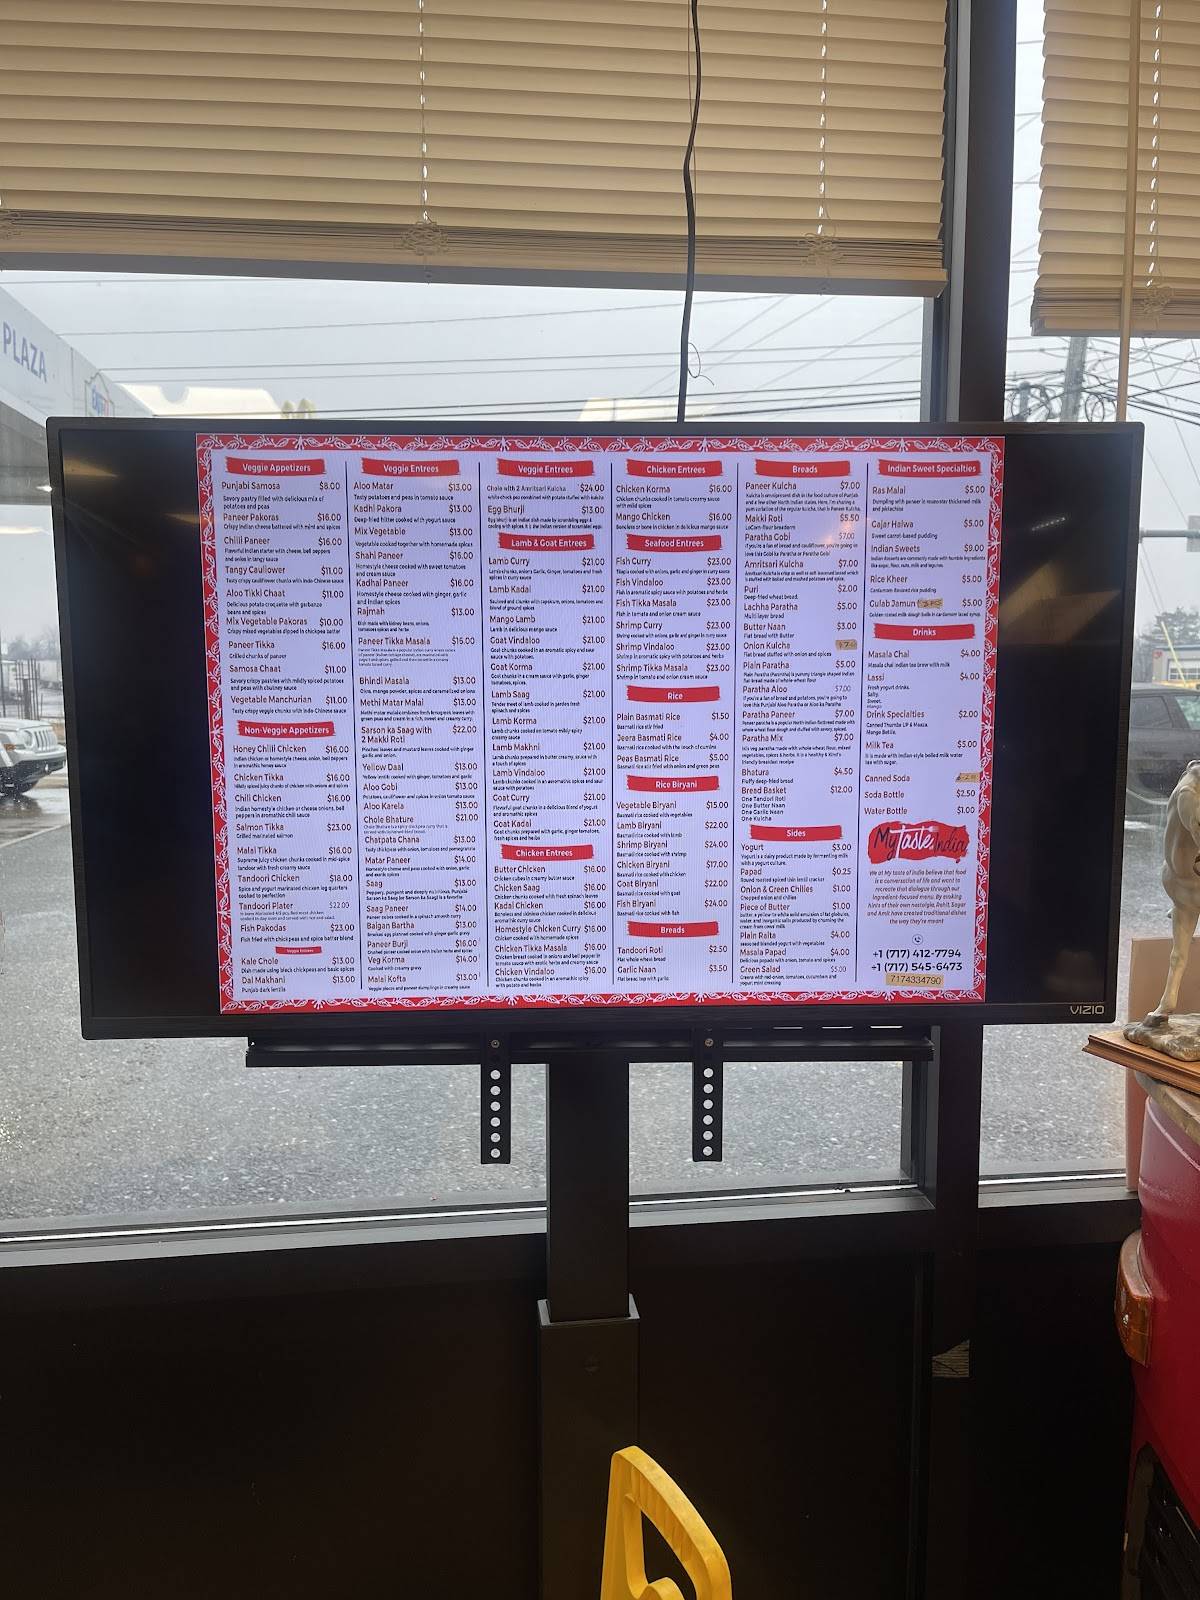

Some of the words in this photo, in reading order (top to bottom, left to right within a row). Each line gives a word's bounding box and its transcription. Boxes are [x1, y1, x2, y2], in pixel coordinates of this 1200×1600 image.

[3, 321, 47, 383] PLAZA
[243, 463, 268, 473] Veggie
[270, 463, 311, 473] Appetizers
[384, 465, 409, 473] Veggie
[411, 465, 438, 473] Entrees
[518, 465, 543, 474] Veggie
[545, 465, 573, 473] Entrees
[888, 464, 911, 472] Indian
[913, 464, 935, 472] Sweet
[937, 464, 976, 474] Specialties
[222, 482, 249, 491] Punjabi
[320, 481, 340, 490] $8.00
[616, 485, 644, 493] Chicken
[709, 485, 732, 493] $16.00
[746, 482, 770, 490] Paneer
[841, 481, 860, 490] $7.00
[965, 485, 985, 494] $5.00
[887, 486, 905, 494] Malai
[488, 506, 502, 514] Egg
[504, 505, 524, 514] Bhurji
[582, 506, 604, 514] $13.00
[841, 514, 859, 522] $5.50
[369, 527, 405, 536] Vegetable
[450, 528, 472, 537] $13.00
[895, 544, 920, 552] Sweets
[964, 544, 984, 552] $9.00
[489, 557, 508, 565] Lamb
[510, 557, 530, 566] Curry
[582, 558, 604, 566] $21.00
[632, 557, 652, 566] Curry
[962, 575, 982, 583] $5.00
[227, 589, 242, 597] Aloo
[245, 589, 262, 597] Tikki
[264, 589, 285, 597] Chaat
[322, 591, 344, 599] $11.00
[358, 607, 384, 617] Rajmah
[451, 608, 474, 616] $13.00
[490, 616, 514, 624] Mango
[516, 615, 535, 623] Lamb
[583, 616, 605, 624] $21.00
[616, 622, 642, 630] Shrimp
[644, 622, 662, 630] Curry
[706, 621, 730, 629] $23.00
[837, 622, 856, 631] $3.00
[913, 628, 936, 636] Drinks
[322, 642, 345, 650] $16.00
[868, 650, 892, 658] Masala
[894, 650, 909, 658] Chai
[961, 650, 980, 658] $4.00
[325, 666, 346, 674] $11.00
[668, 692, 683, 700] Rice
[453, 698, 476, 707] $13.00
[712, 712, 729, 720] $1.50
[887, 711, 924, 719] Specialties
[959, 710, 978, 718] $2.00
[245, 726, 287, 735] Non-Veggie
[289, 726, 329, 735] Appetizers
[326, 774, 350, 782] $16.00
[672, 781, 697, 790] Biryani
[830, 786, 852, 794] $12.00
[957, 806, 975, 814] $1.00
[327, 824, 351, 832] $23.00
[638, 821, 661, 830] Biryani
[705, 821, 728, 829] $22.00
[874, 827, 897, 860] My
[741, 844, 763, 852] Yogurt
[741, 868, 762, 876] Papad
[331, 924, 354, 932] $23.00
[618, 946, 647, 954] Tandoori
[709, 945, 727, 953] $2.50
[886, 950, 910, 959] (717)
[913, 950, 961, 958] 412-7794
[885, 963, 908, 972] (717)
[912, 963, 962, 971] 545-6473
[891, 975, 941, 984] 7174334790
[1070, 1006, 1104, 1014] VIZIO
